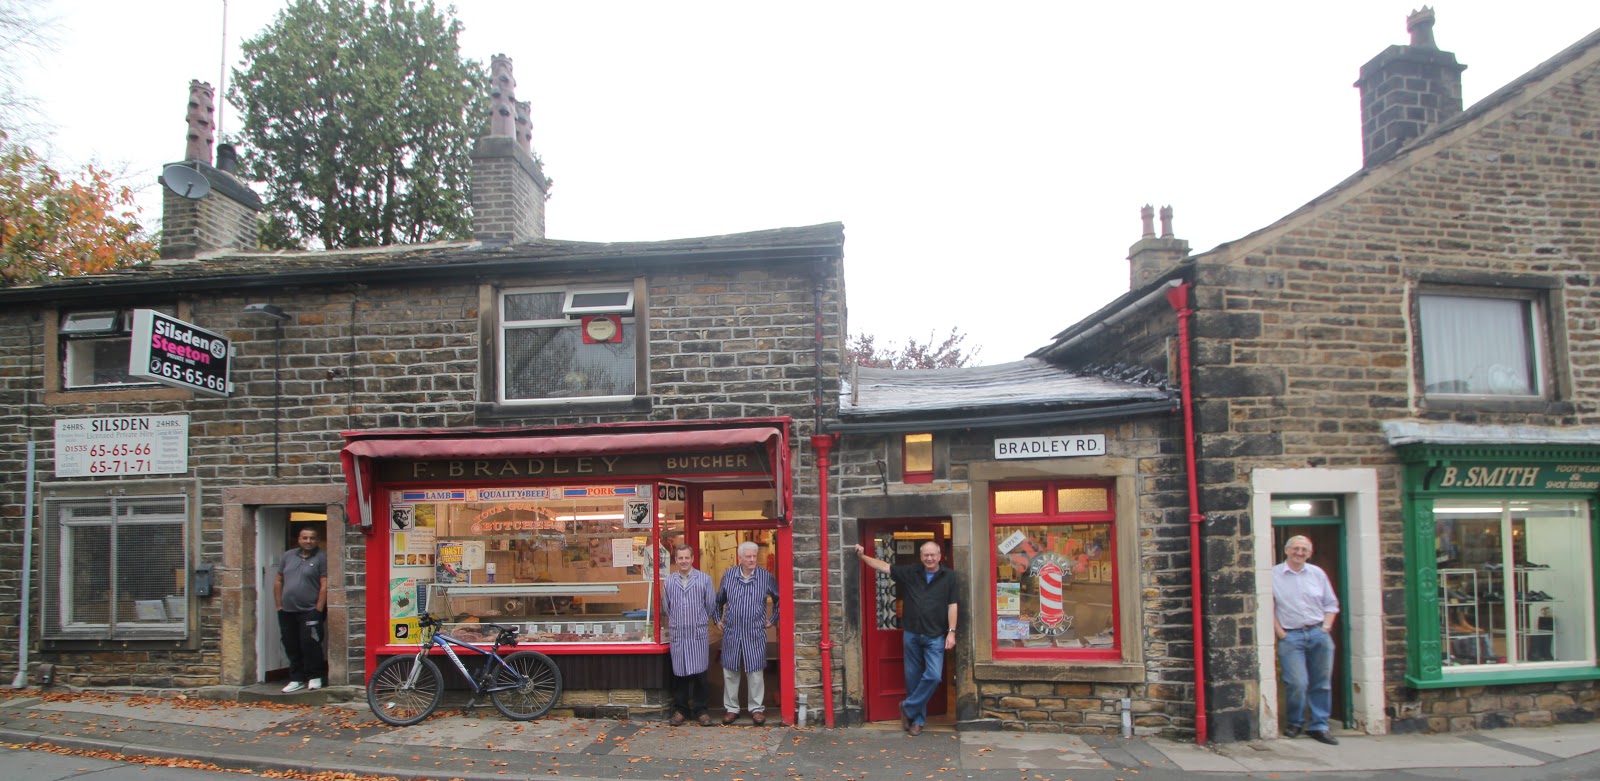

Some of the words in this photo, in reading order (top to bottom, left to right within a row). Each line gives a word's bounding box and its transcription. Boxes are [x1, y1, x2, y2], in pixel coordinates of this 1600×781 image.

[155, 320, 209, 350] Silsden
[152, 334, 210, 364] Steeton
[92, 418, 149, 431] SILSDEN
[116, 430, 137, 438] Private
[140, 429, 154, 437] Hire
[65, 444, 88, 452] 01535
[90, 443, 151, 457] 65-65-66
[999, 440, 1070, 454] BRADLEY
[1076, 439, 1101, 451] RD.
[90, 460, 151, 473] 65-71-71
[413, 462, 435, 478] F.
[449, 457, 619, 477] BRADLEY
[667, 454, 748, 469] BUTCHER
[1569, 473, 1581, 481] &
[1545, 480, 1567, 489] SHOE
[1567, 481, 1599, 489] REPAIRS
[483, 490, 522, 499] QUALITY
[525, 490, 546, 498] BEEF
[588, 487, 615, 496] PORK
[474, 505, 506, 522] YOUR
[507, 503, 557, 522] QUALITY
[482, 520, 554, 531] BUTCHER
[1004, 535, 1020, 549] OPEN
[1039, 625, 1066, 635] SHOP
